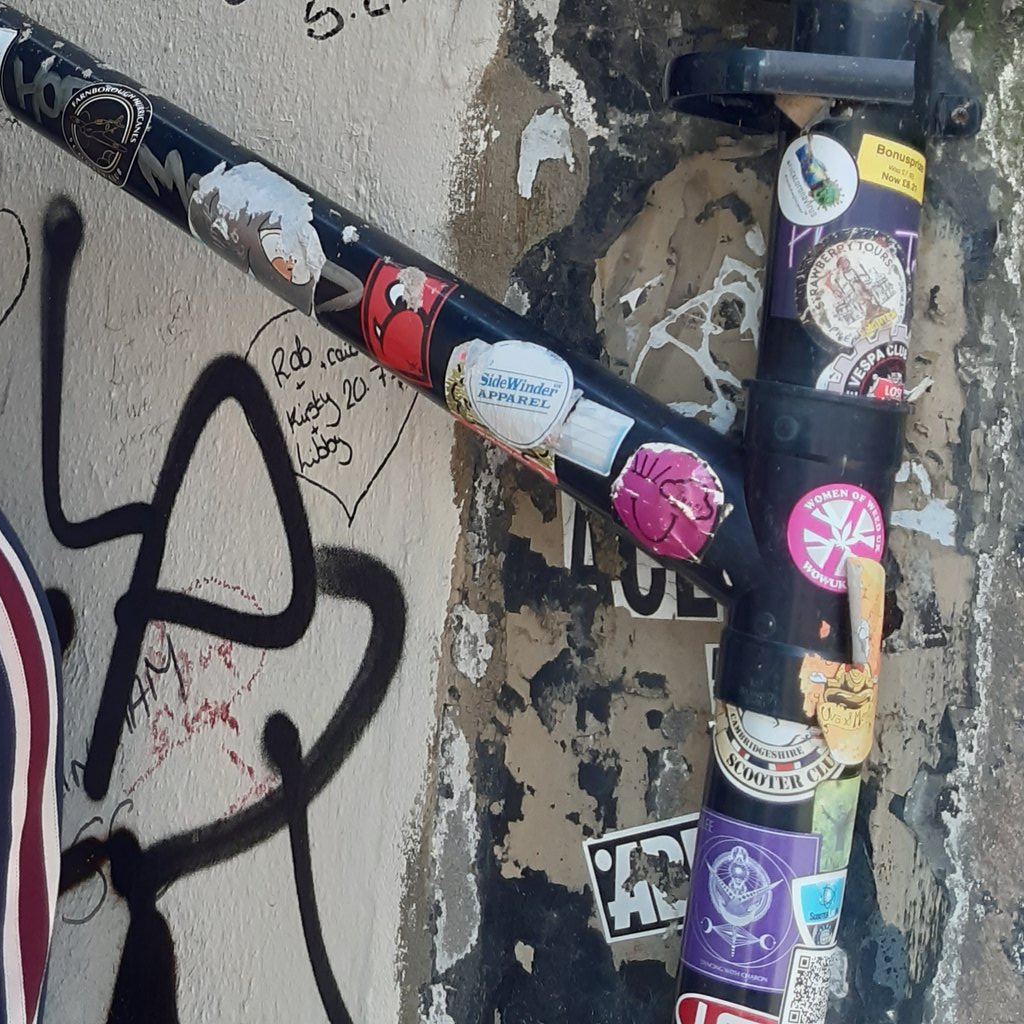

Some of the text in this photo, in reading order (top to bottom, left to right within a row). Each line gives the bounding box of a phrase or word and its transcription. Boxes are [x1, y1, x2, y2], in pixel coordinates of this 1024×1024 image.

[857, 240, 895, 268] TOURS
[271, 335, 312, 388] Rob
[848, 347, 885, 387] VESPA
[477, 388, 551, 410] APPAREL
[479, 371, 559, 398] SideWinder
[803, 489, 882, 553] WOMEN OF WEED UK
[802, 560, 848, 590] WOWUK
[729, 712, 805, 759] CAMBRIDGESHIRE
[725, 752, 837, 791] SCOOTER CLU
